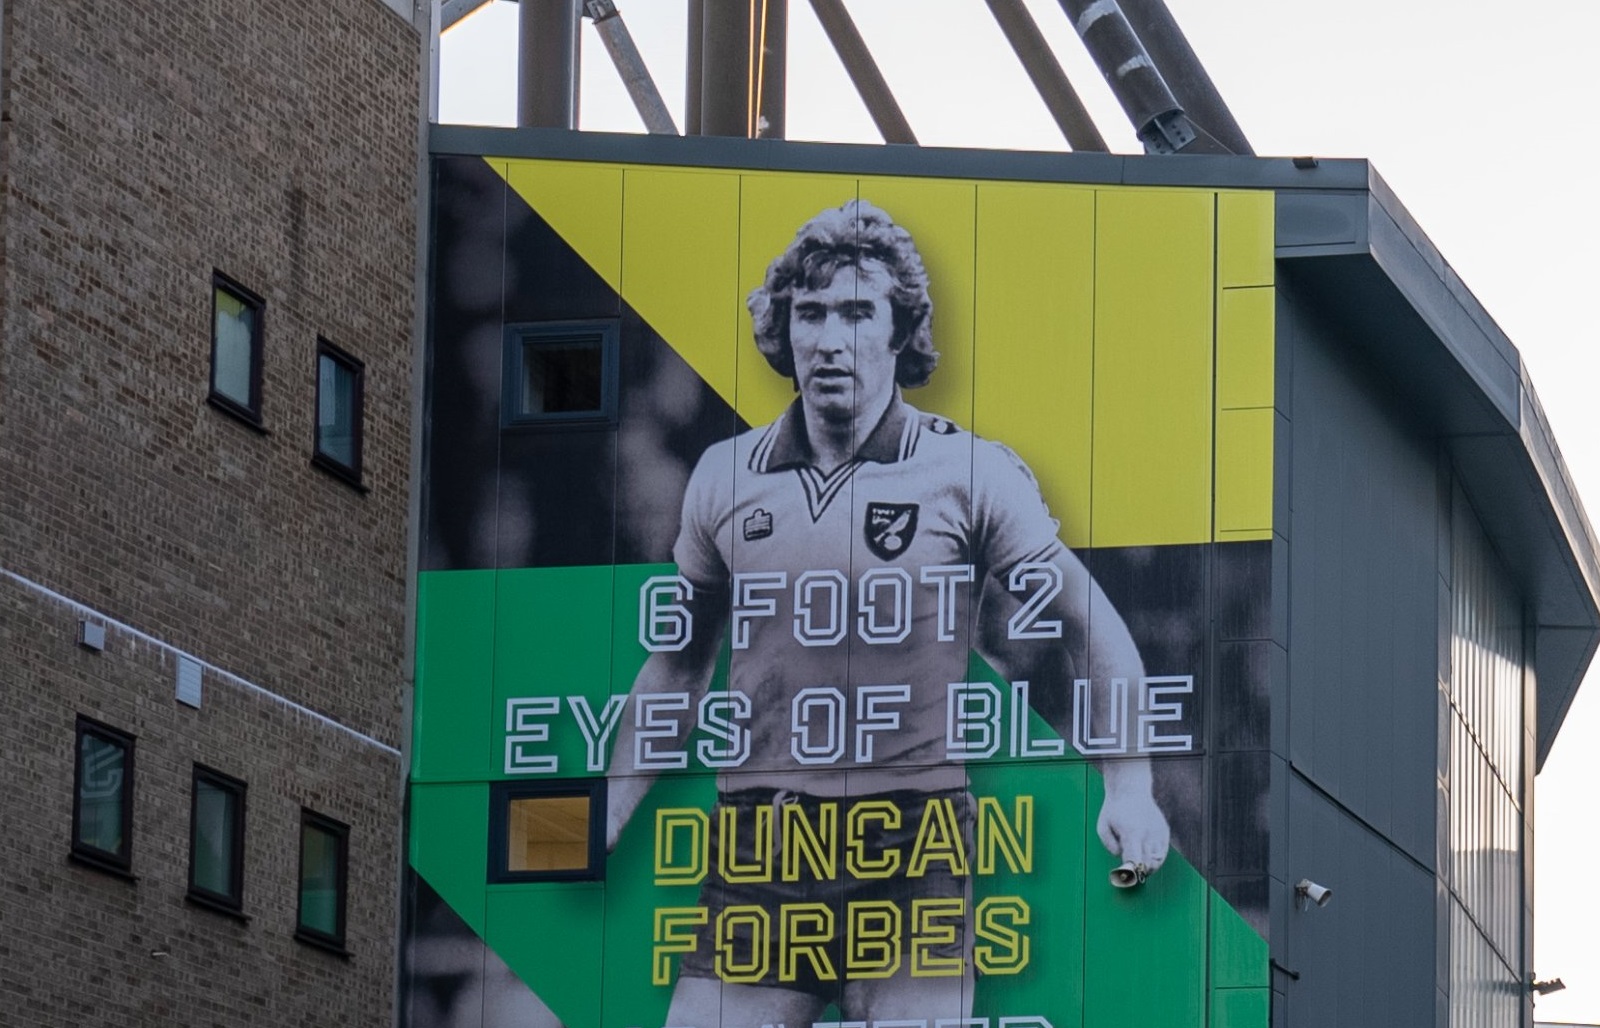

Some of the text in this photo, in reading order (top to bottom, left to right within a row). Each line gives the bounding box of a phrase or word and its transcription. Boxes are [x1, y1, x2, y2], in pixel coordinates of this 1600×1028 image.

[638, 561, 1064, 653] 6 FOOT 2
[503, 674, 1195, 775] EYES OF BLUE
[653, 795, 1036, 887] DUNCAN
[651, 895, 1031, 987] FORBES
